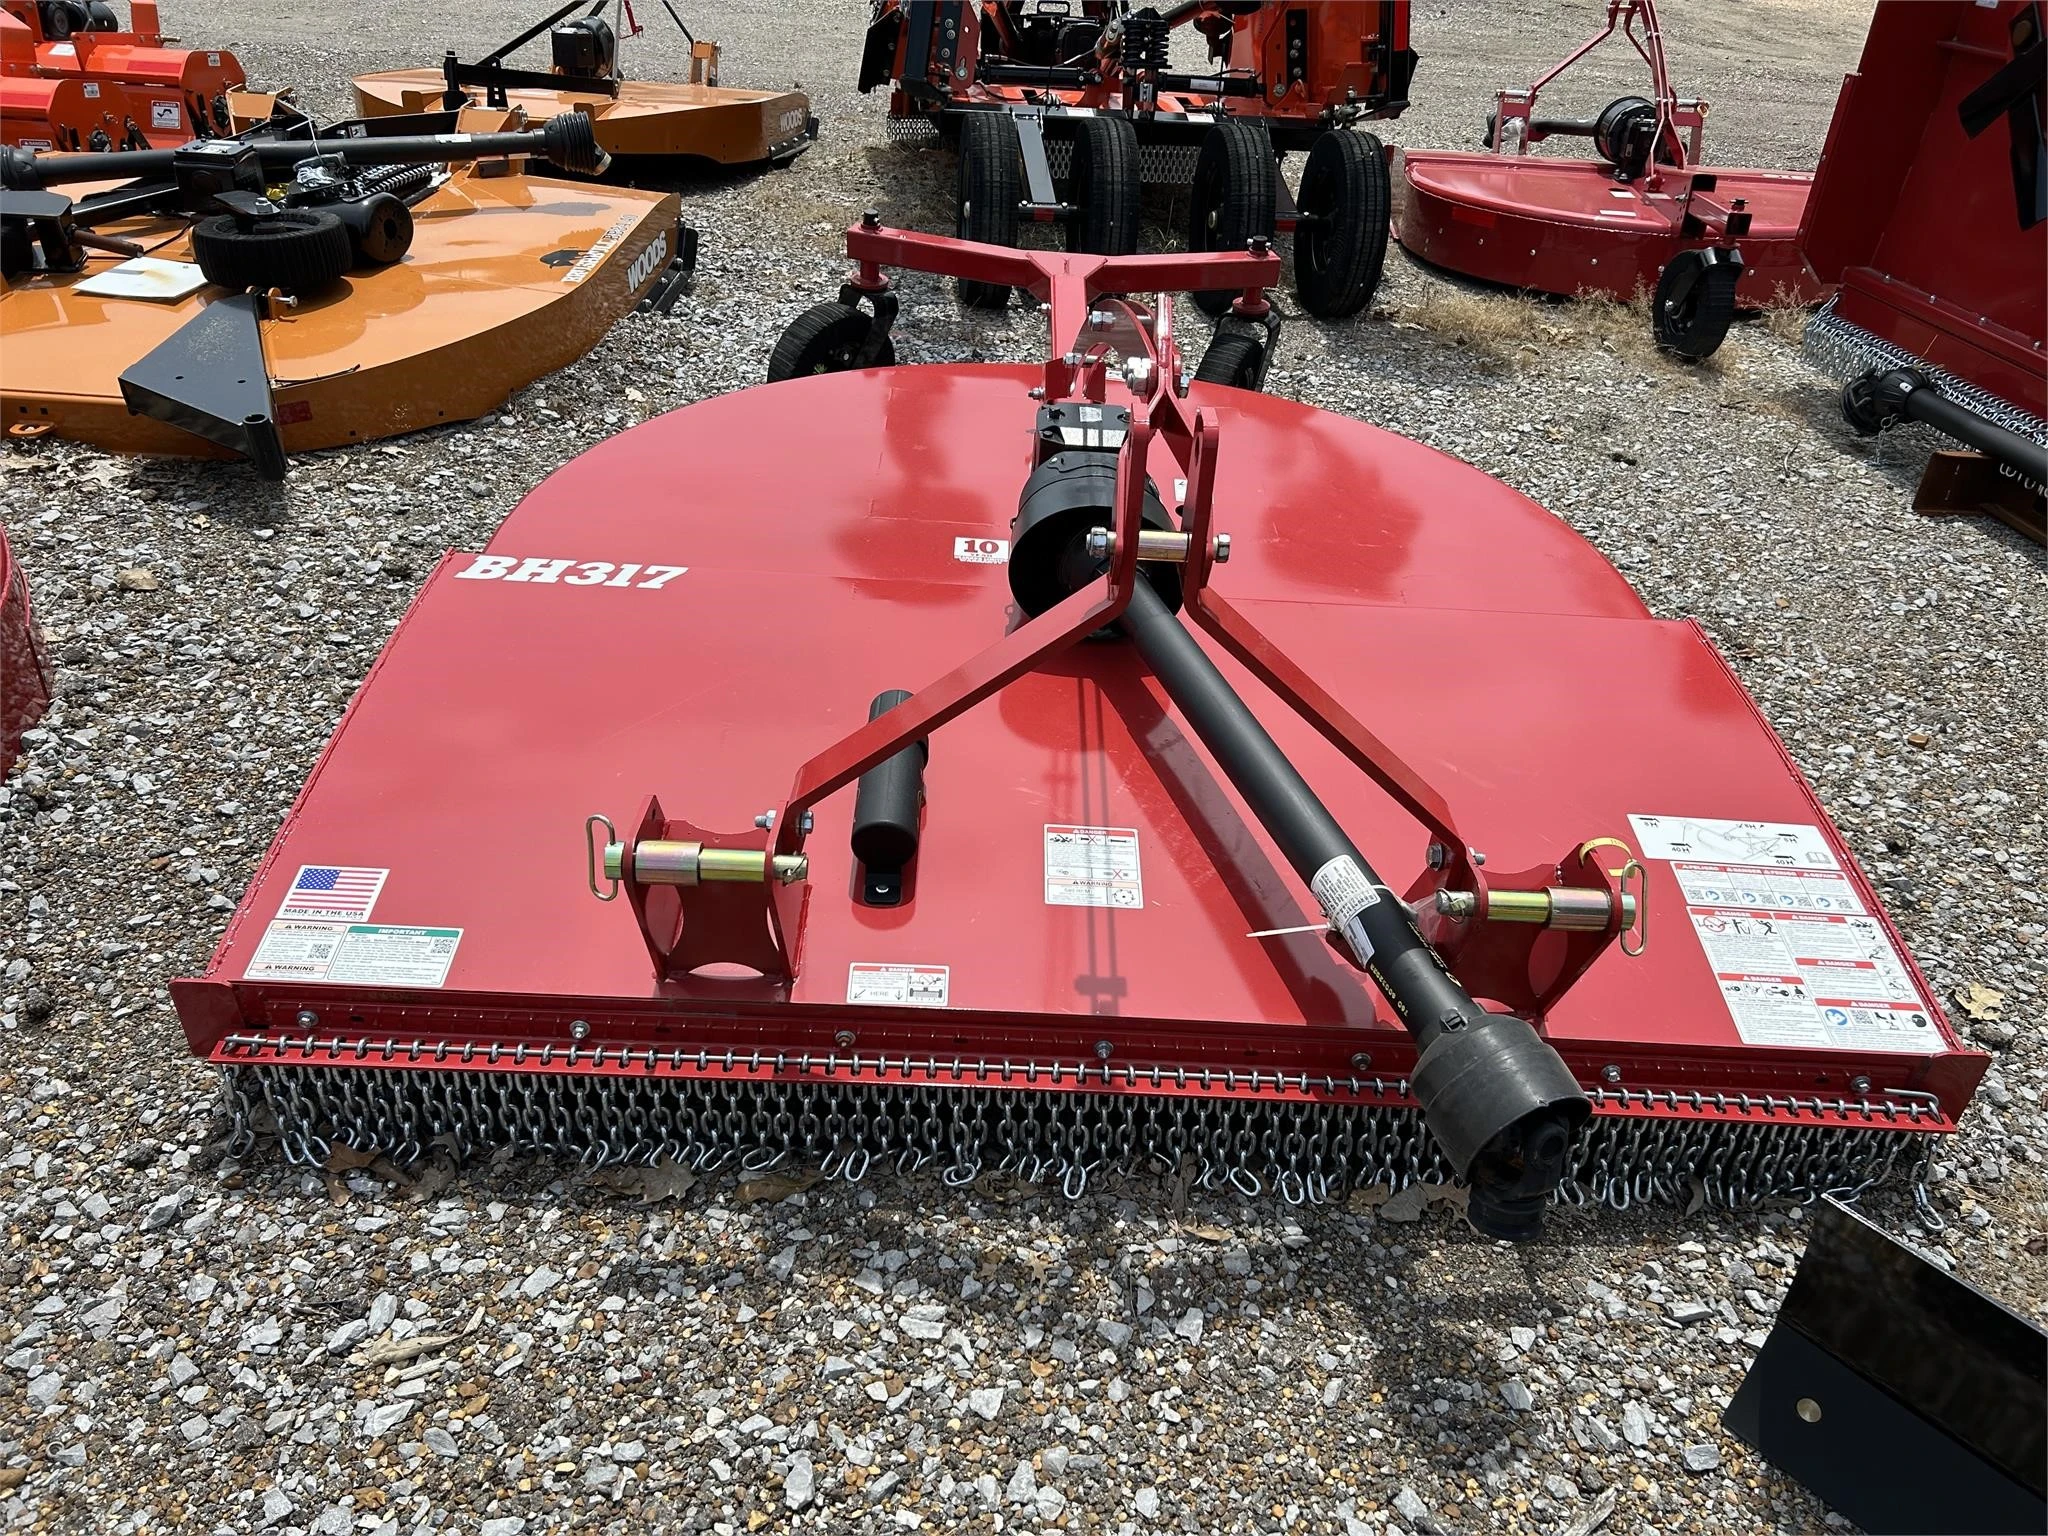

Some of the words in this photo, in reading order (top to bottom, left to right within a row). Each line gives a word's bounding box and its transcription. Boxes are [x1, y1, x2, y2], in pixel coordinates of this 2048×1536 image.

[780, 108, 803, 132] WOODS
[627, 231, 667, 294] WOODS
[964, 540, 999, 554] 10
[454, 555, 689, 589] BH317
[378, 928, 428, 936] IMPORTANT
[1750, 975, 1782, 983] DANGER
